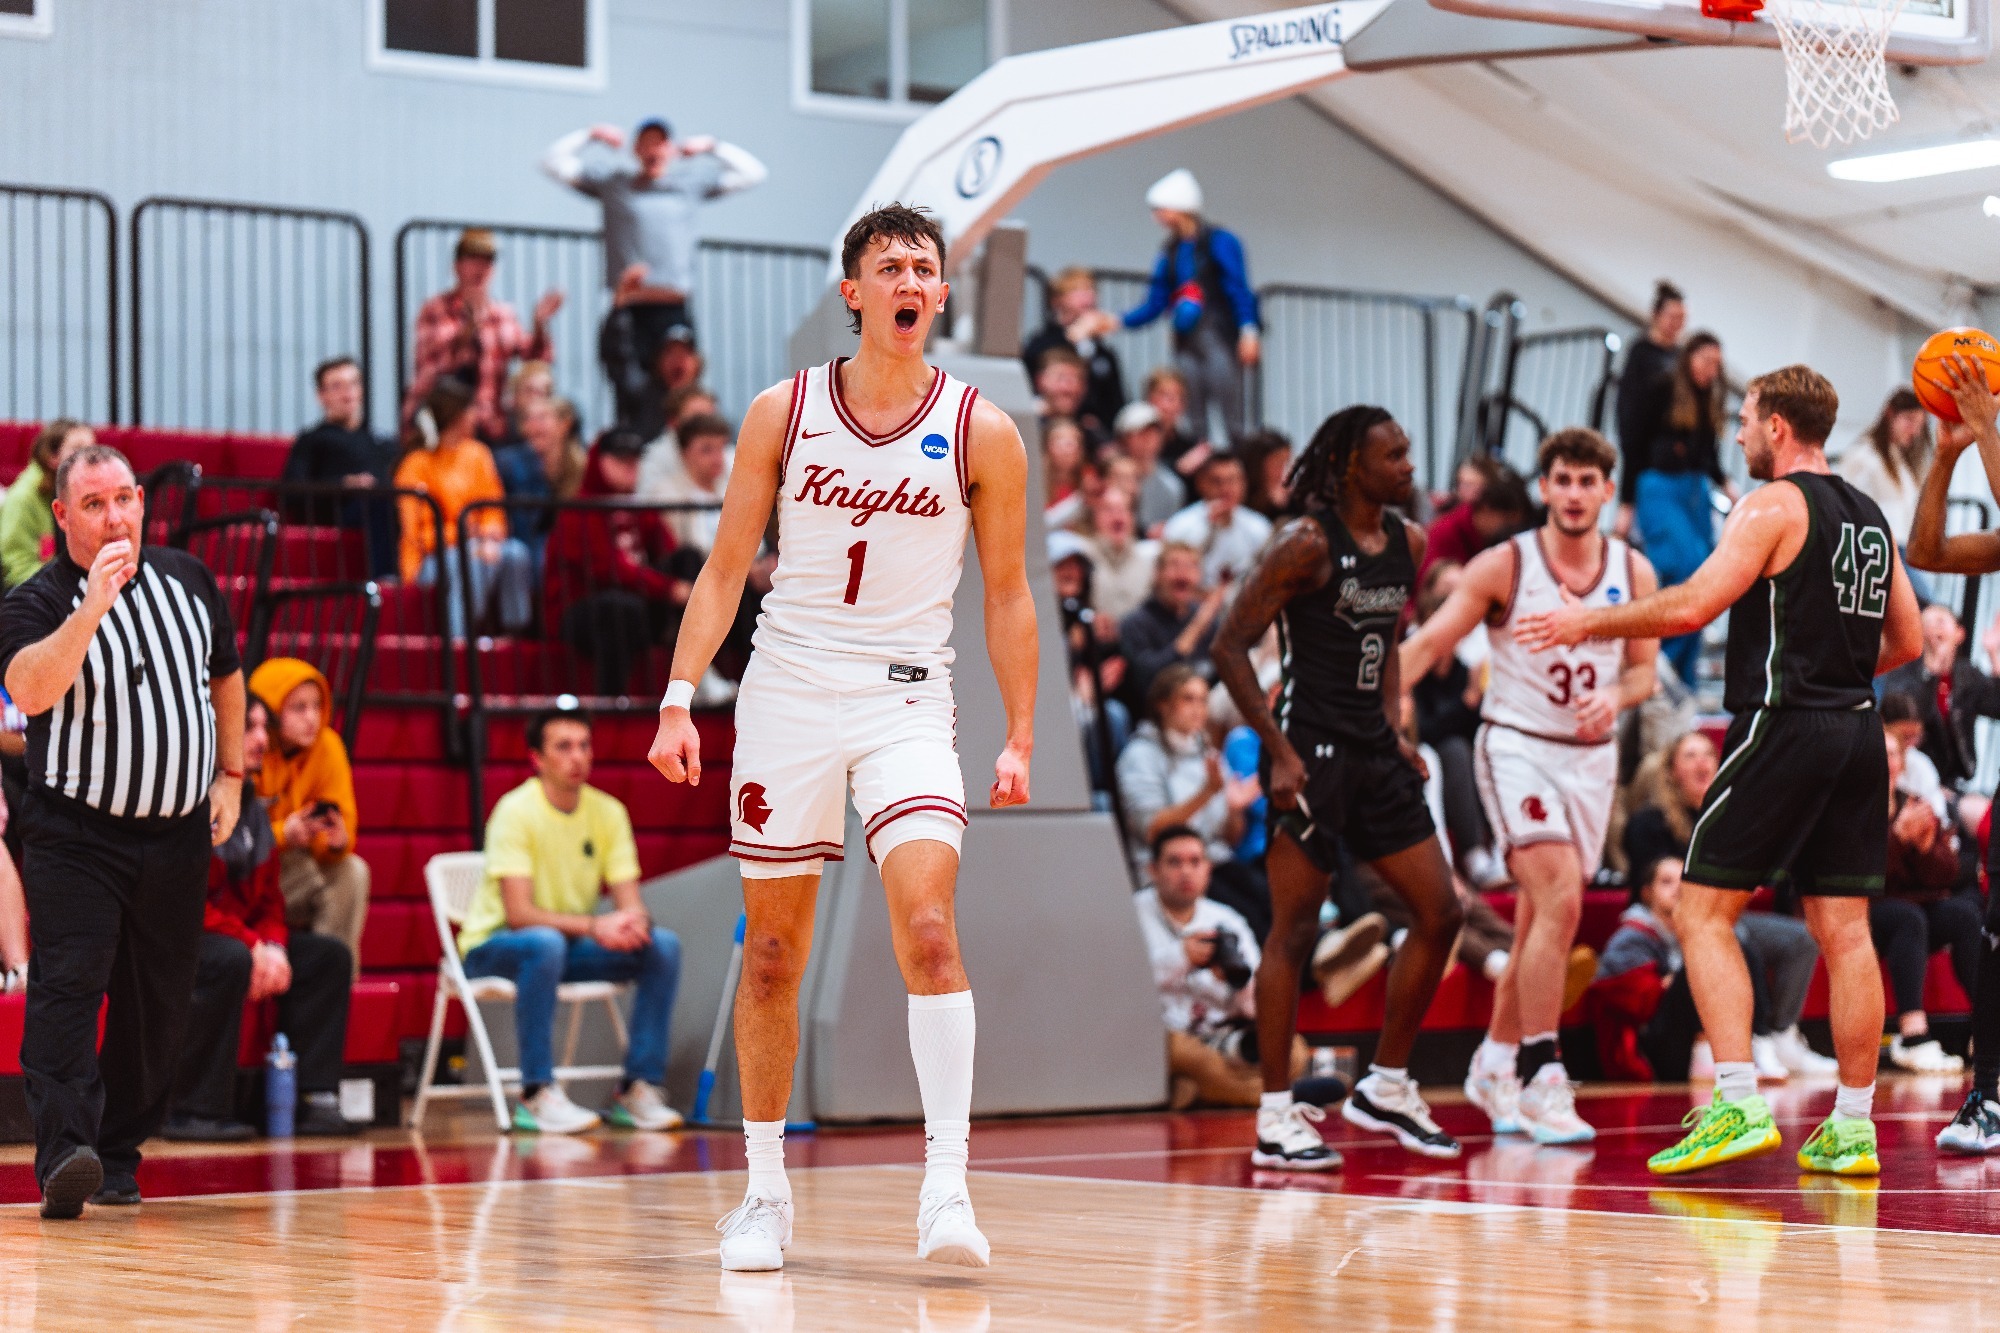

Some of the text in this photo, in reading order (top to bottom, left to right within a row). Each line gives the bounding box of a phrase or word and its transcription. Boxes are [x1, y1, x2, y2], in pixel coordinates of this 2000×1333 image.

[1230, 7, 1341, 60] SPALDING
[924, 445, 949, 455] NCAA
[794, 464, 945, 527] Knights
[843, 540, 867, 605] 1
[1832, 522, 1889, 619] 42
[1356, 633, 1385, 690] 2
[1547, 662, 1596, 706] 33
